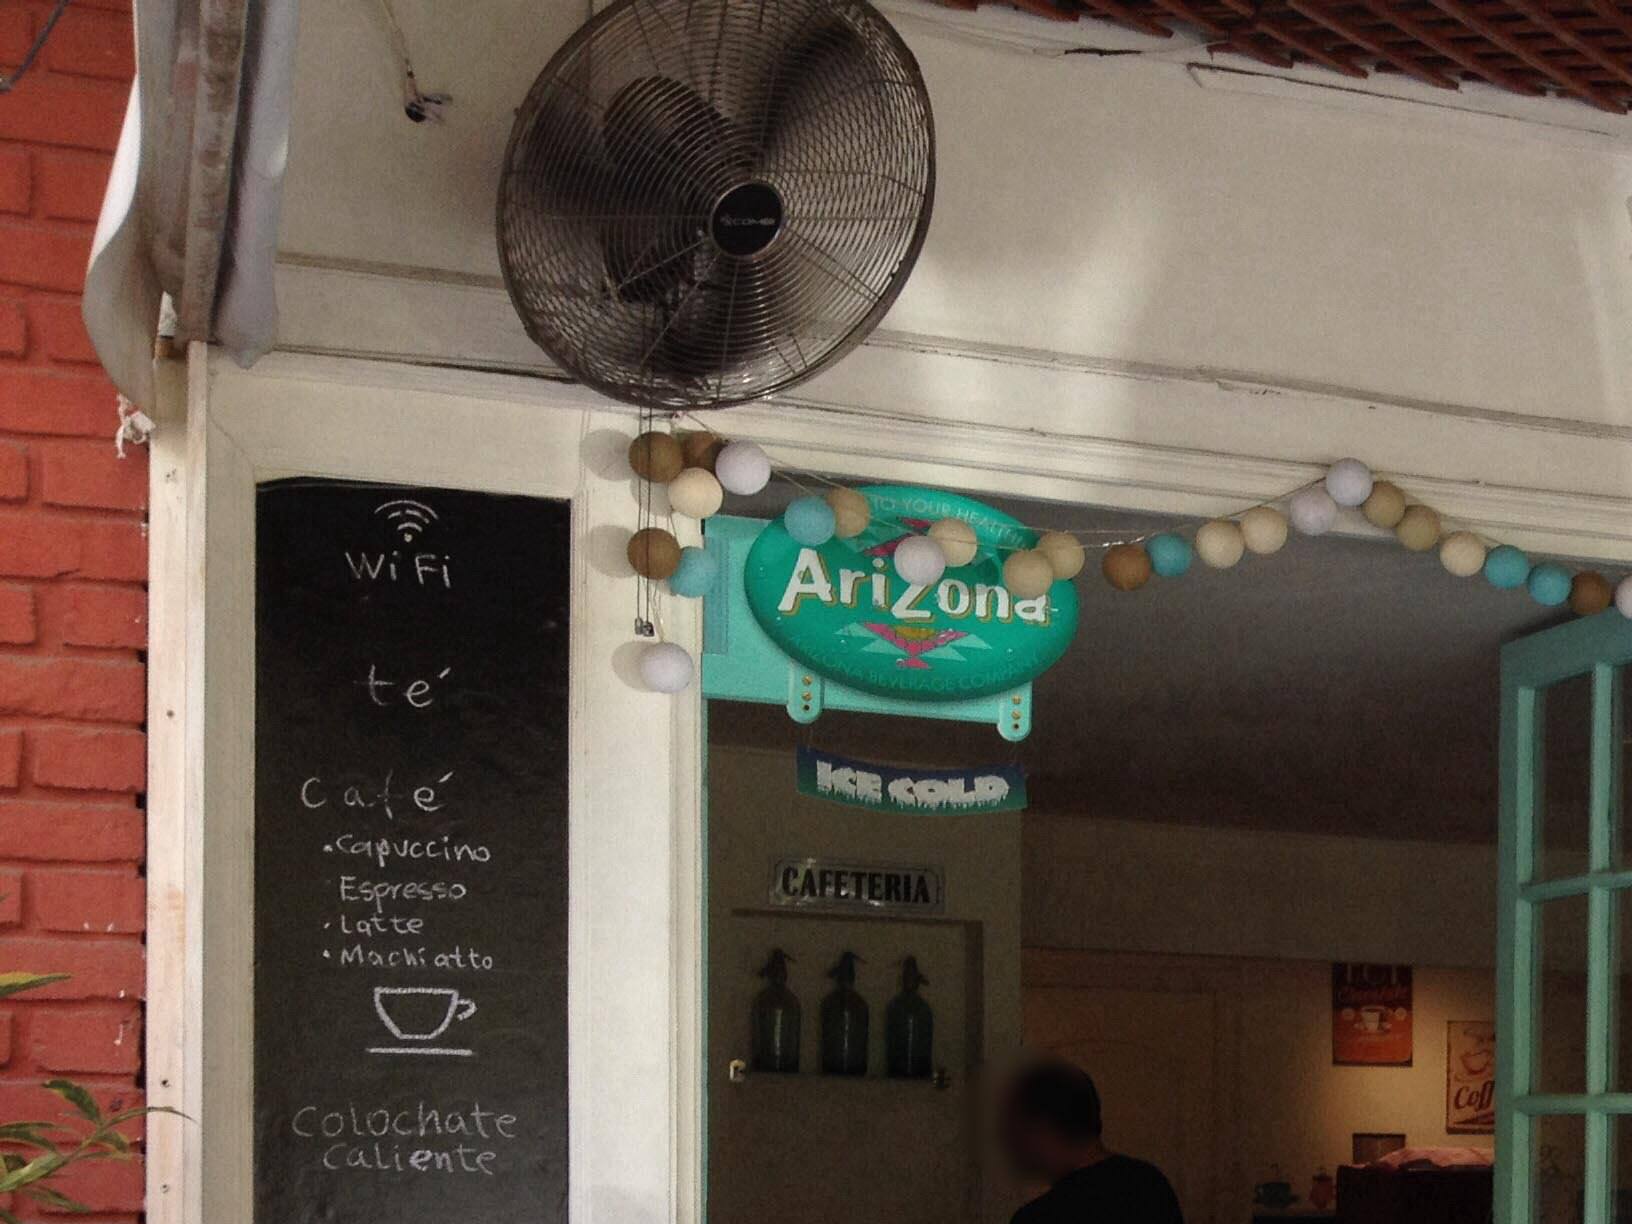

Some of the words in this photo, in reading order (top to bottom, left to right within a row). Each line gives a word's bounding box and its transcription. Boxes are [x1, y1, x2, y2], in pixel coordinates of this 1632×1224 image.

[817, 760, 882, 804] ICE
[888, 775, 1010, 810] COLD
[336, 833, 492, 867] Capuccino
[340, 875, 467, 913] Espresso
[782, 866, 931, 904] CAFETERIA
[292, 1102, 518, 1140] Colochate
